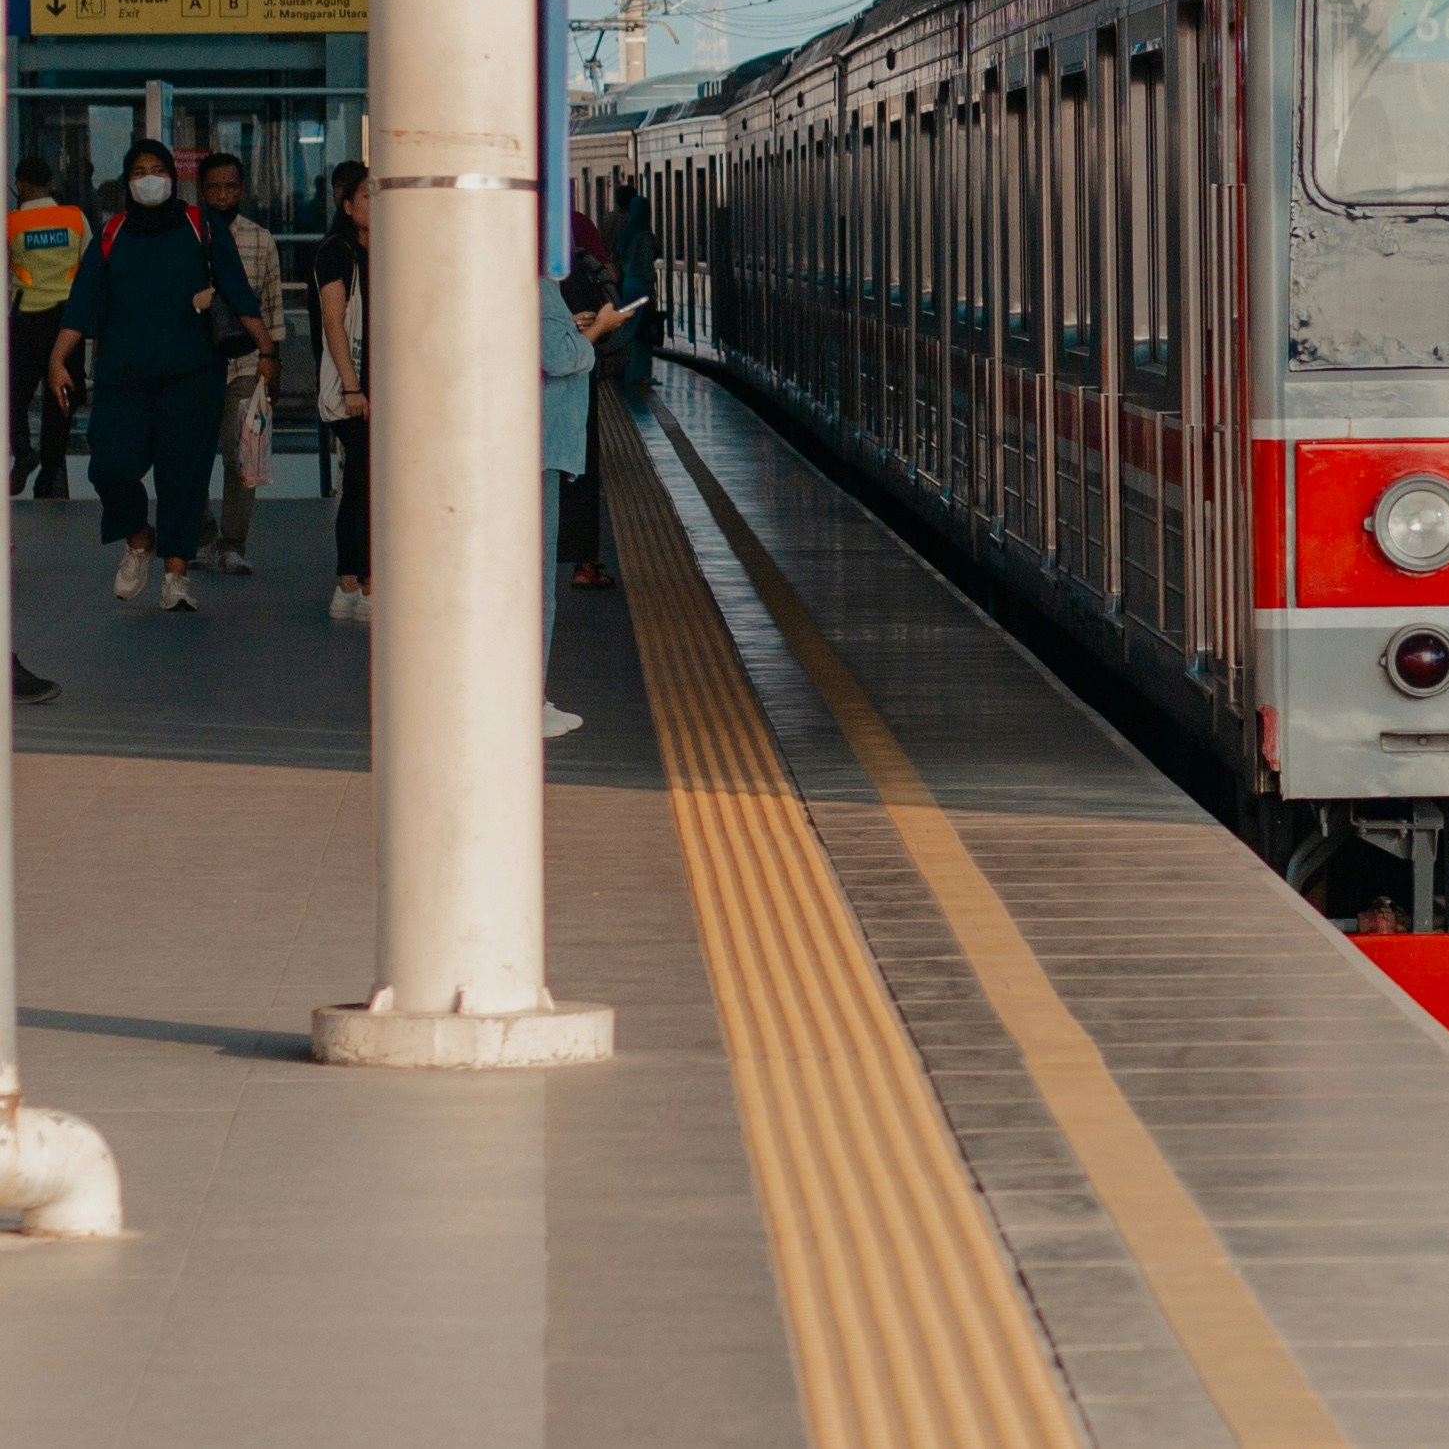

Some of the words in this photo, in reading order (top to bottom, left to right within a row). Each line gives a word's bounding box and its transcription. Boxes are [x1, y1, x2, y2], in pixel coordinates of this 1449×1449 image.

[118, 8, 140, 19] Exit
[263, 10, 276, 19] Jl.
[280, 9, 336, 20] Manggarai
[26, 231, 50, 245] PAM
[50, 229, 68, 243] KCI
